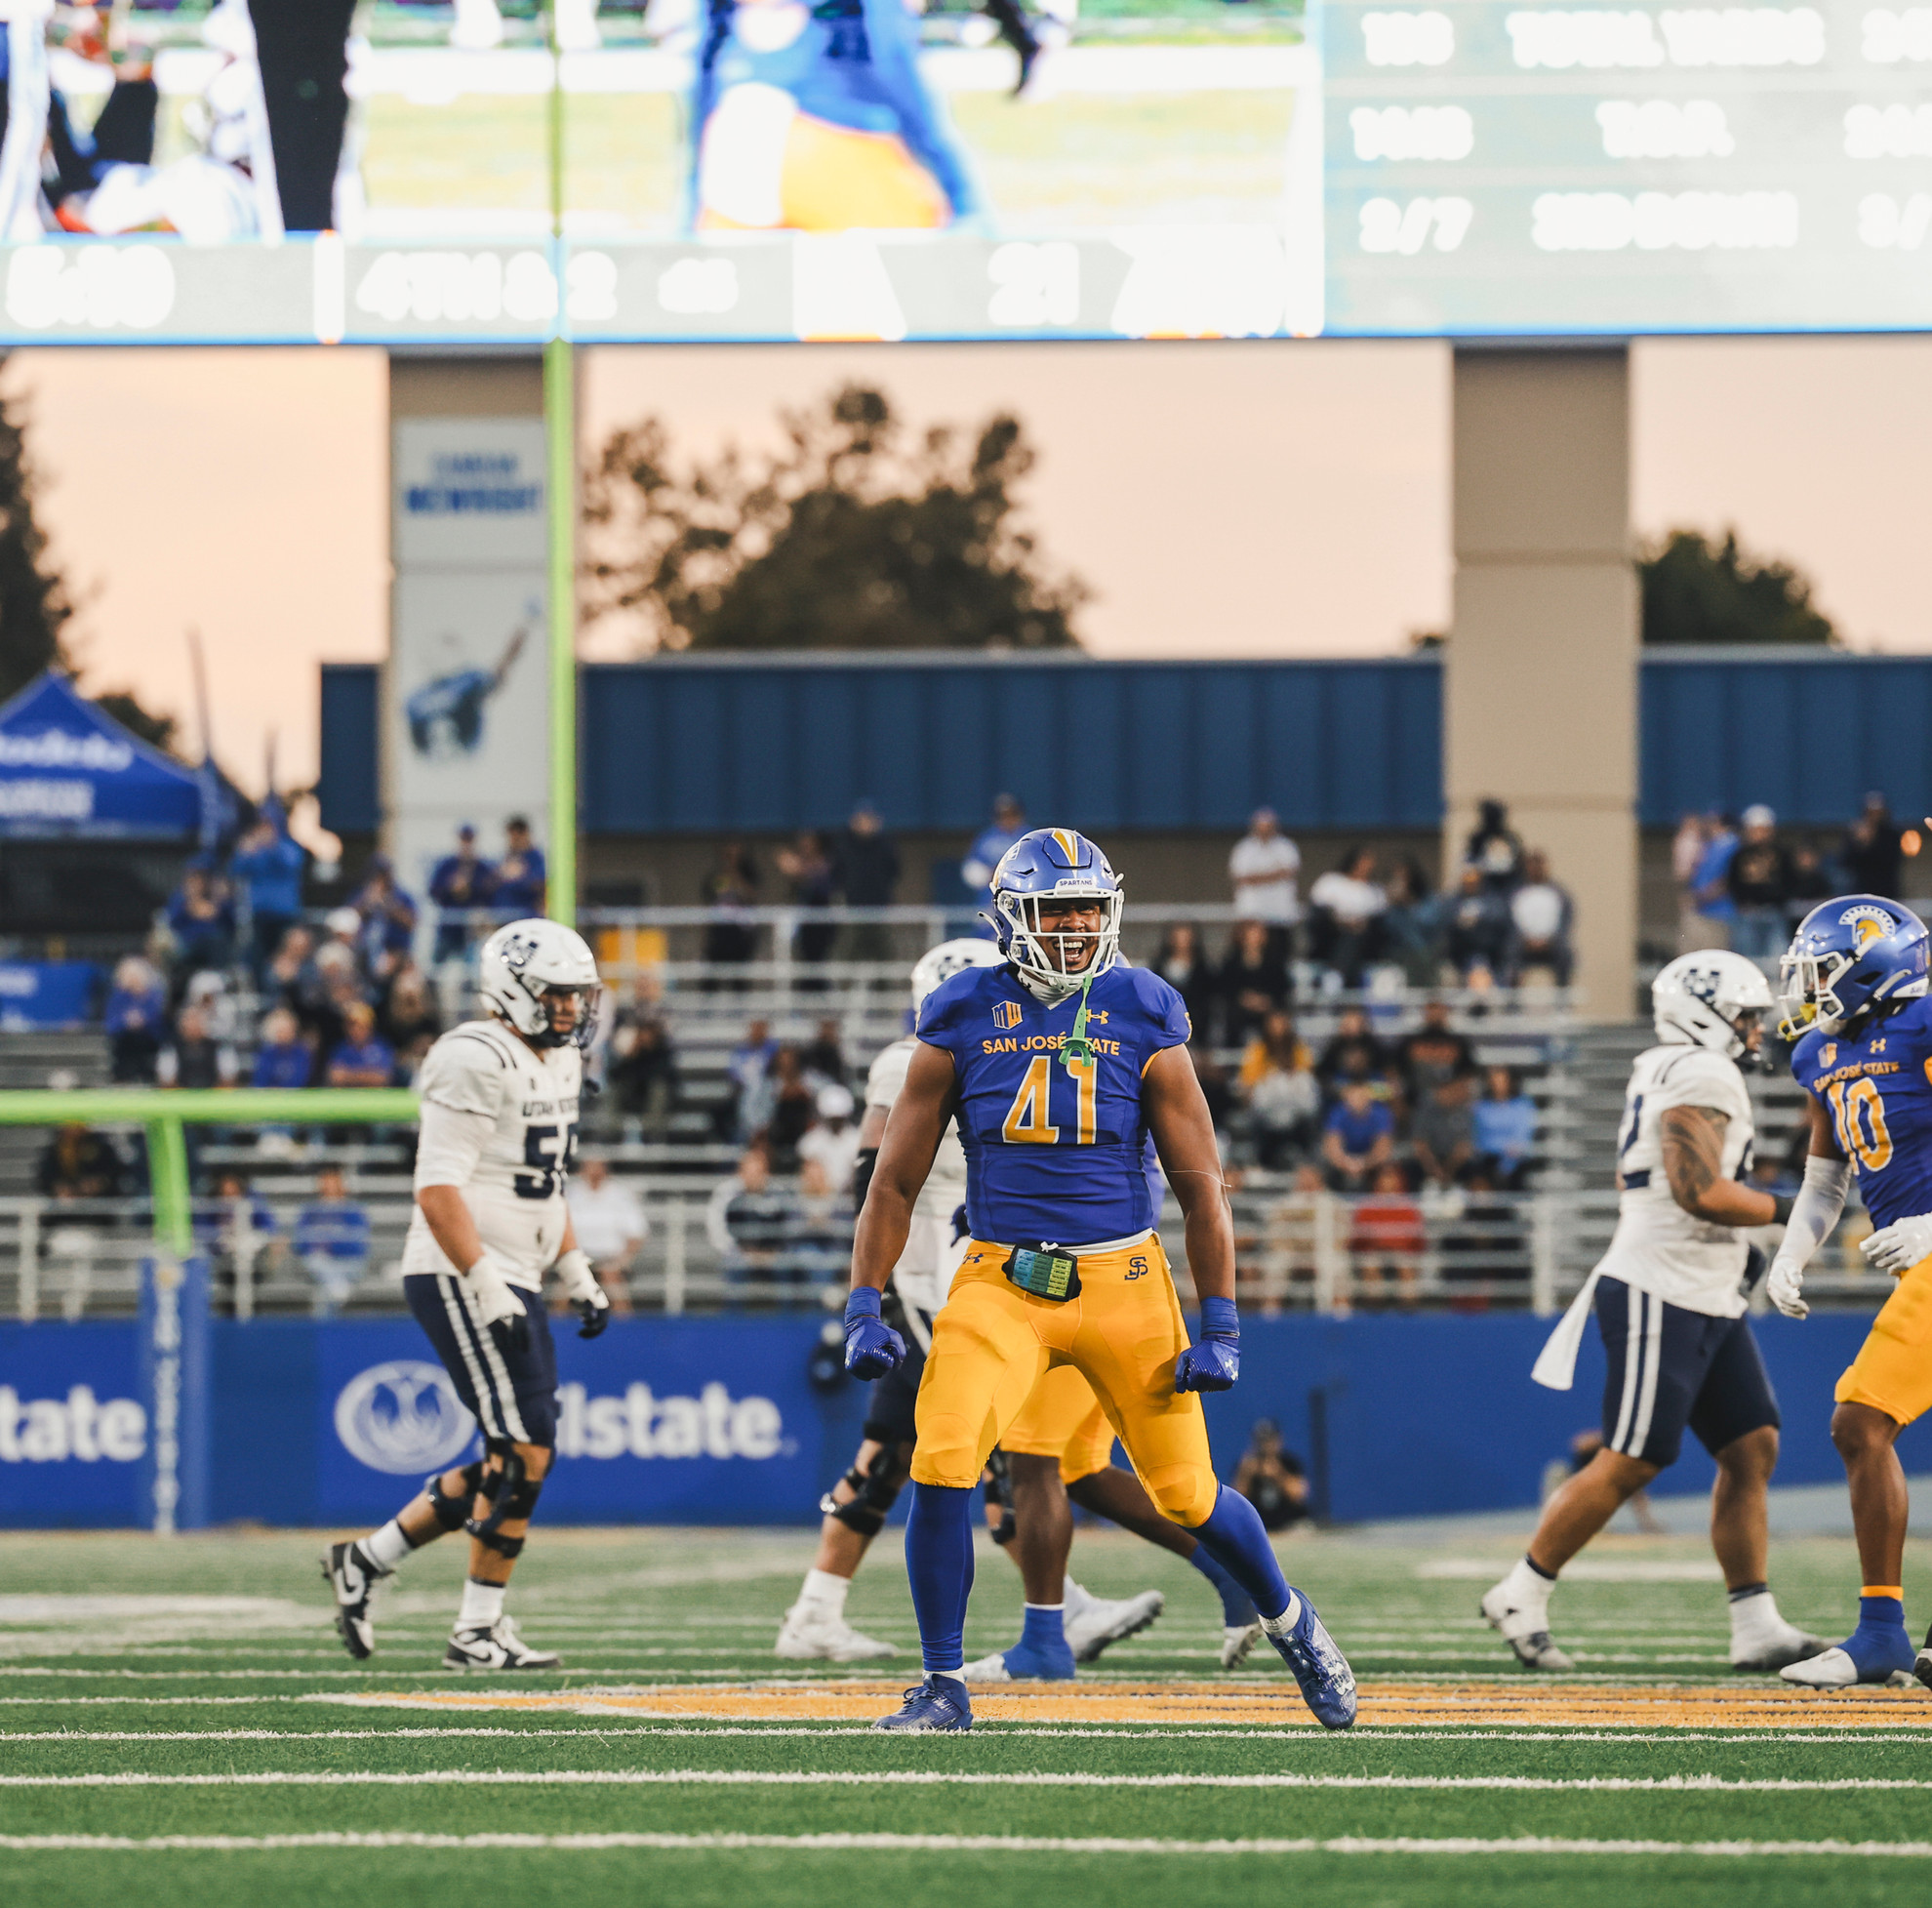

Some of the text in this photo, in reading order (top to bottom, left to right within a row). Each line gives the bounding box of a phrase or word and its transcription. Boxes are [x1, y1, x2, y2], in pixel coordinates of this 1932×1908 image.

[982, 1037, 1018, 1055] SAN
[1021, 1031, 1067, 1052] JOSÉ
[1002, 1055, 1098, 1145] 41
[1827, 1076, 1894, 1176] 10
